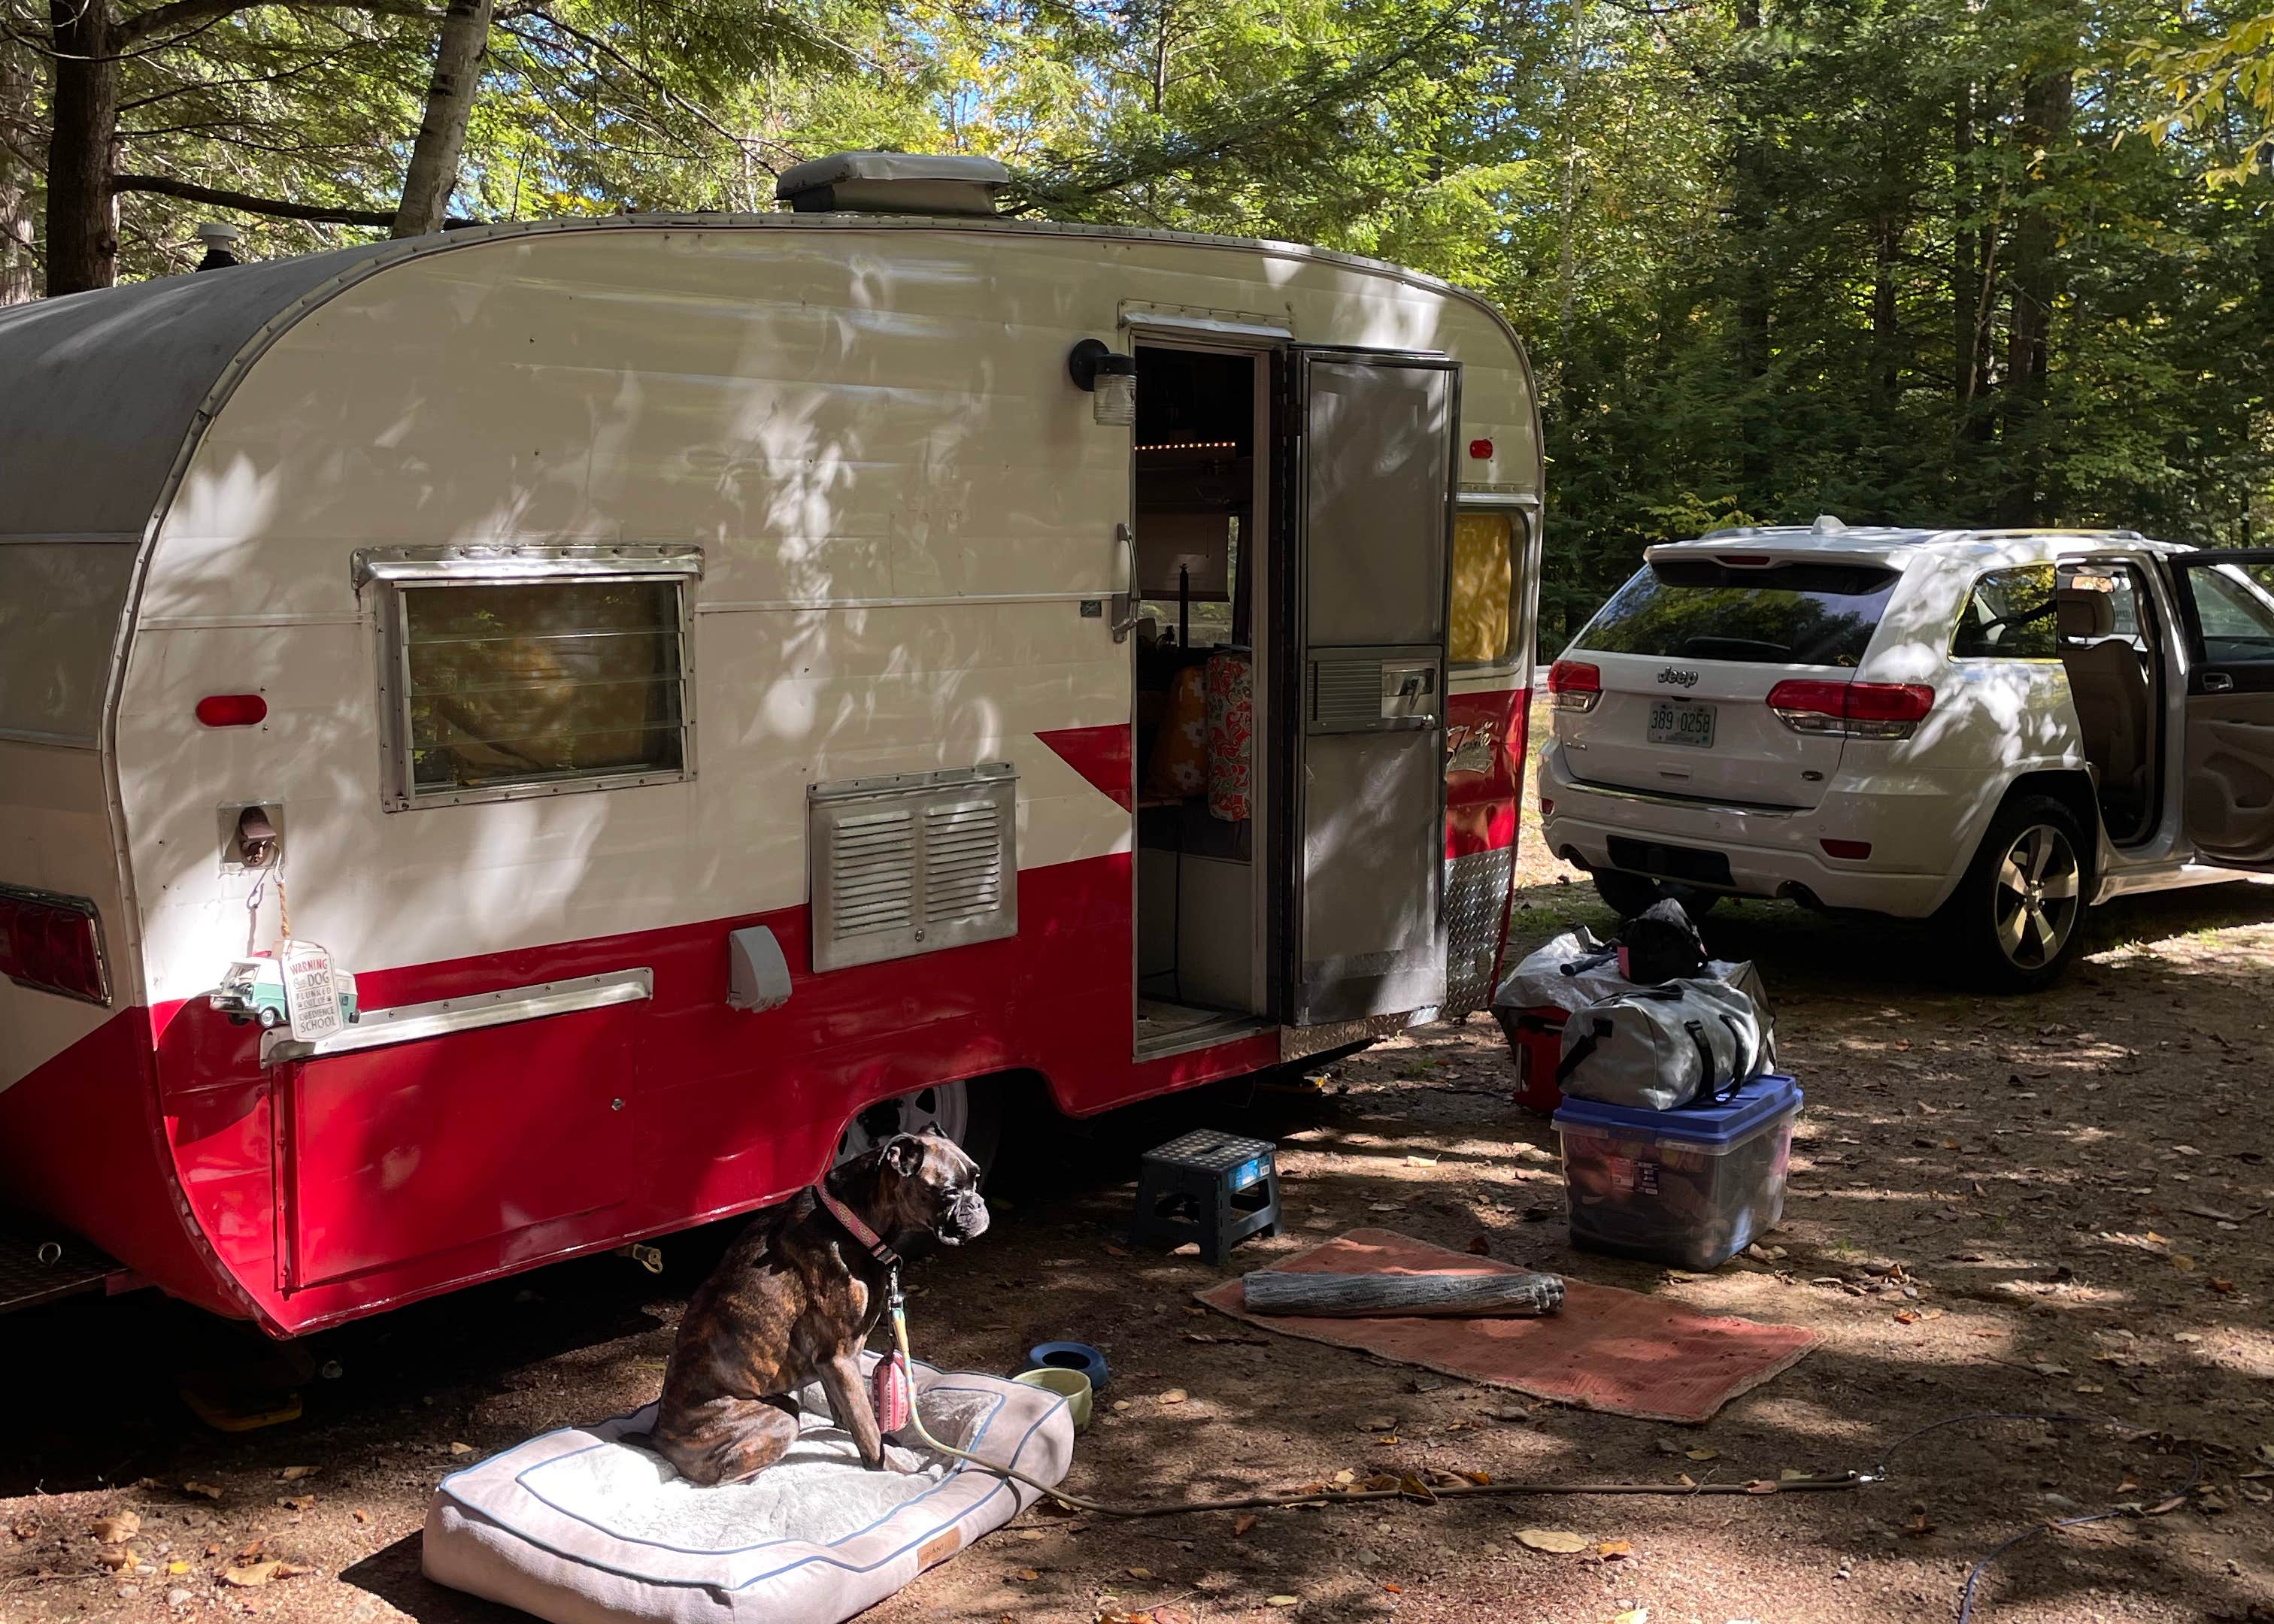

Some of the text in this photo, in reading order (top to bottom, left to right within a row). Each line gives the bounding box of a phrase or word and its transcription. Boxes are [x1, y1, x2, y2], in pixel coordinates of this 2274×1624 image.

[1657, 665, 1699, 688] Jeep
[1651, 710, 1710, 733] 389 0258
[290, 959, 328, 975] WARNING
[308, 971, 330, 986] DOG
[296, 987, 331, 1001] FLUNKED
[299, 1006, 334, 1020] OBEDIENCE
[301, 1017, 336, 1032] SCHOOL
